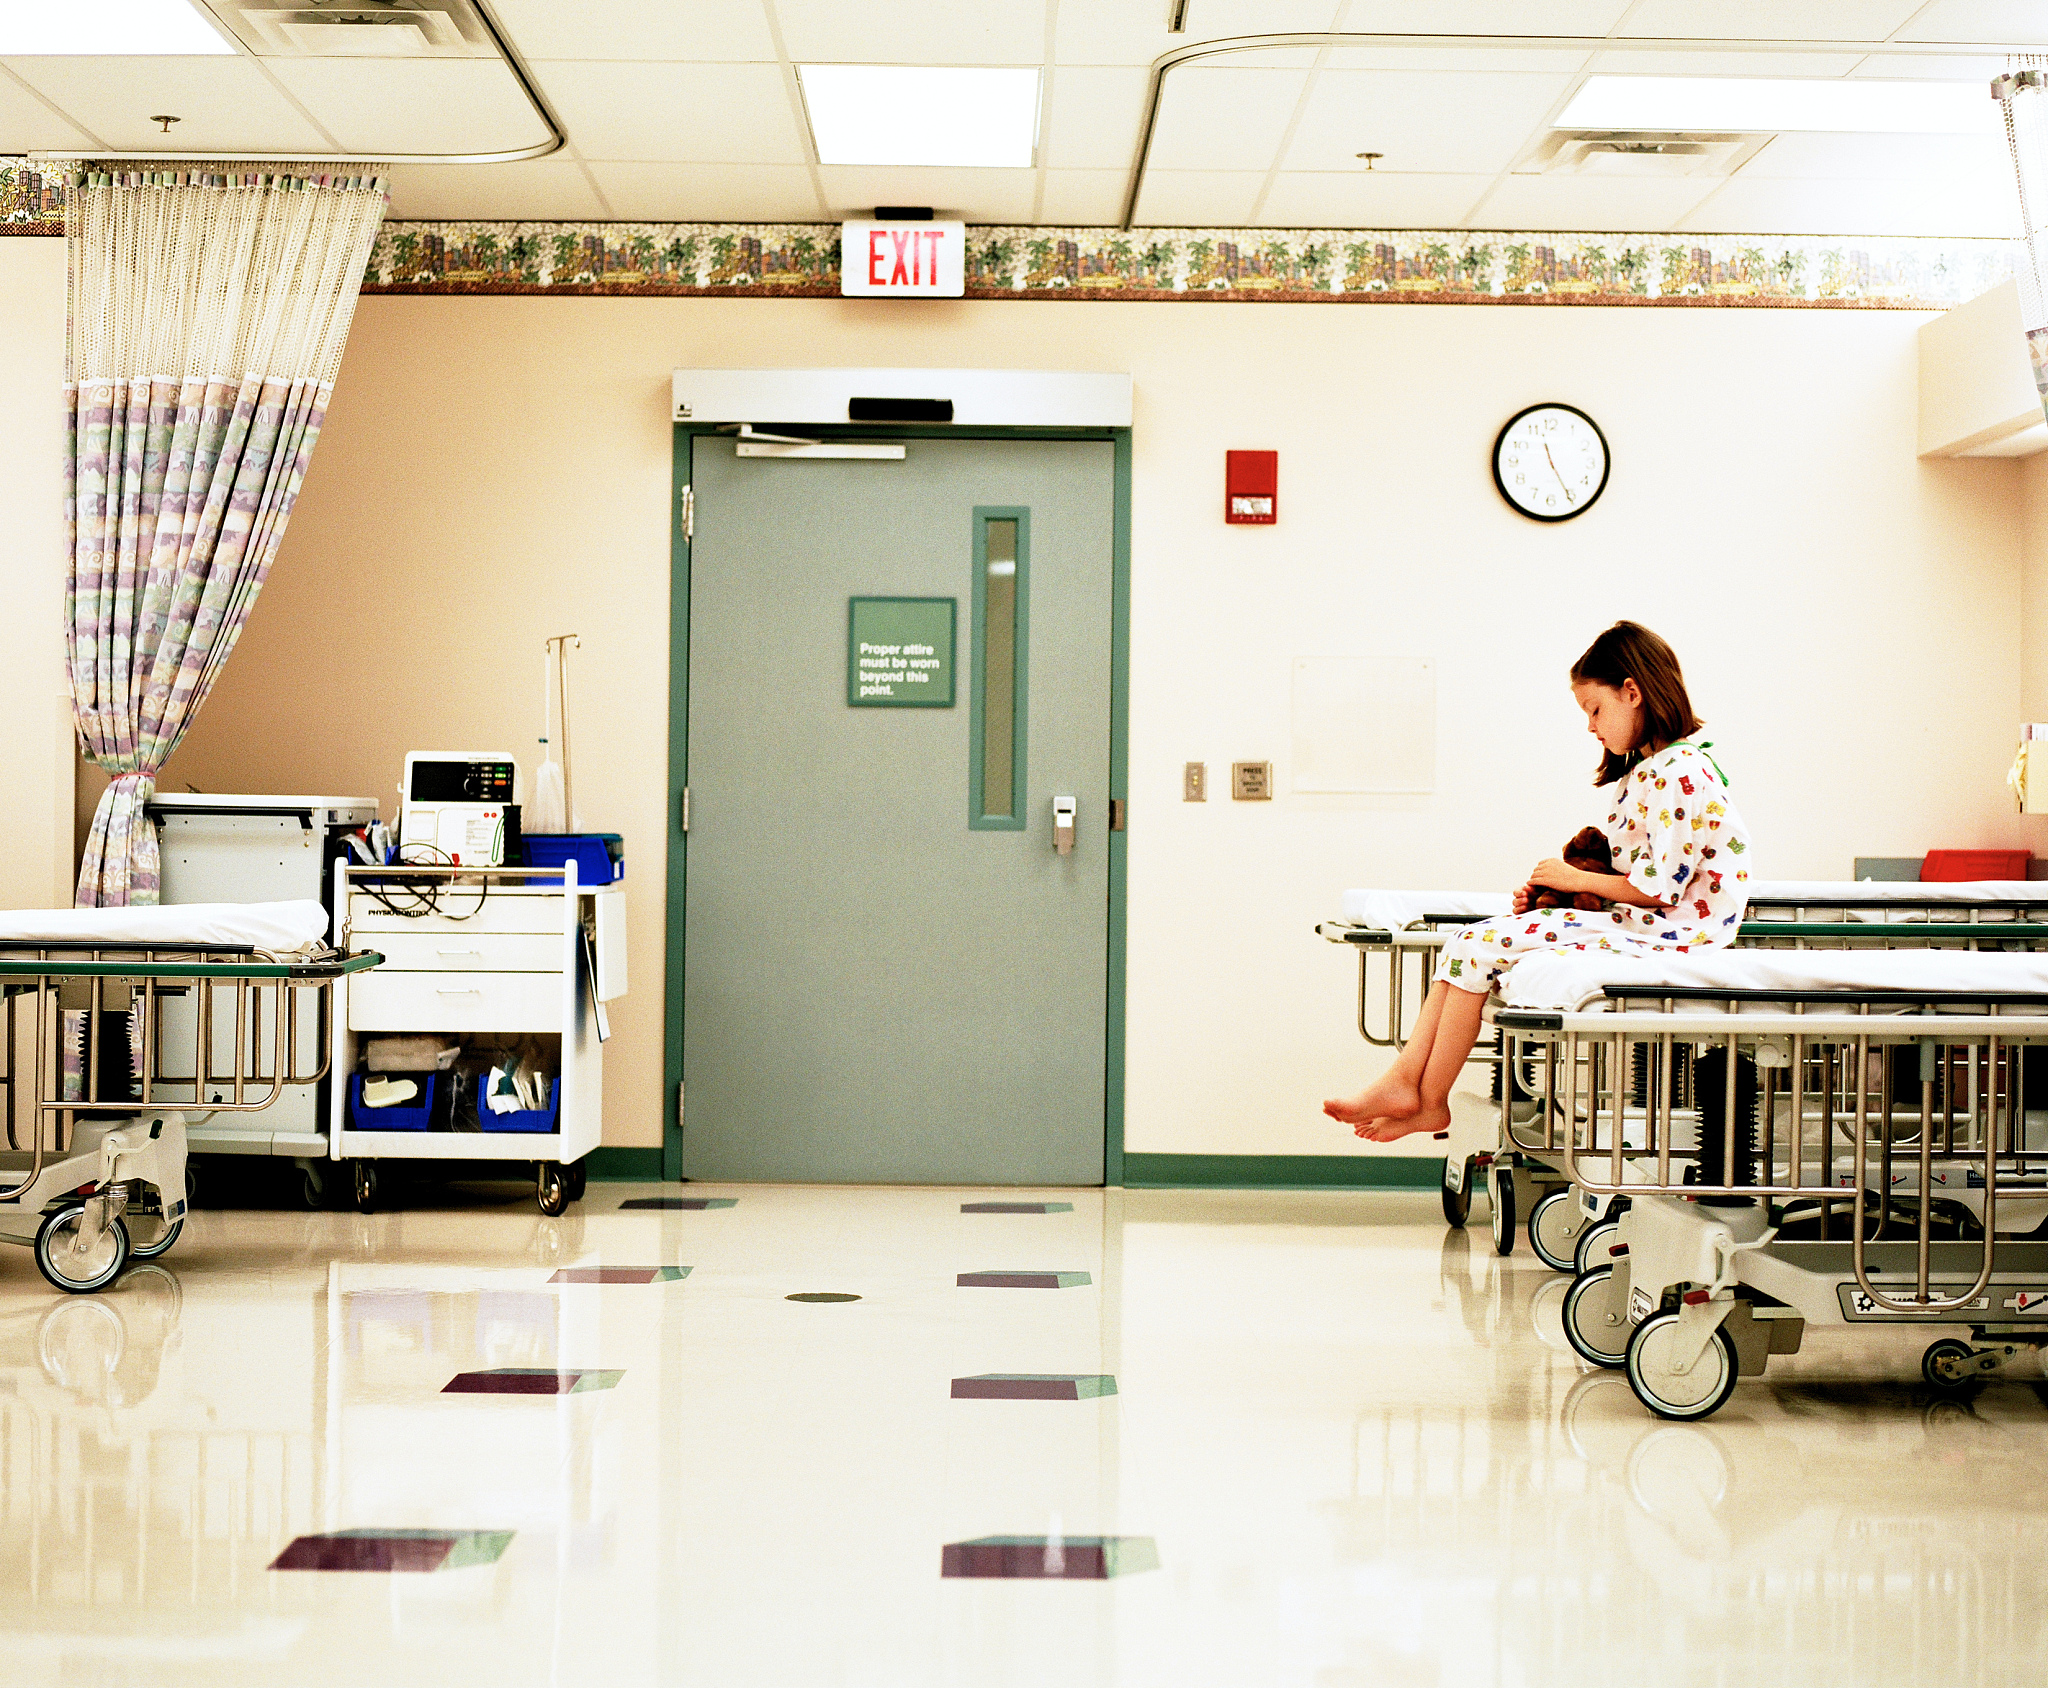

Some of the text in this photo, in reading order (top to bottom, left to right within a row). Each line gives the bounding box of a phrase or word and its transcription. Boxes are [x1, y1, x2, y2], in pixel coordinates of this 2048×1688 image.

[869, 230, 944, 286] EXIT
[1528, 424, 1539, 435] 11
[1544, 418, 1558, 431] 12
[1513, 441, 1529, 450] 10
[1581, 440, 1590, 452] 2
[1508, 456, 1519, 468] 9
[1586, 458, 1596, 470] 3
[1516, 473, 1525, 485] 8
[1580, 475, 1589, 485] 4
[1531, 487, 1539, 500] 7
[1546, 494, 1556, 507] 6
[860, 642, 934, 657] Proper attire
[860, 657, 940, 669] must be worn
[859, 670, 930, 685] beyond this
[860, 684, 894, 698] point.
